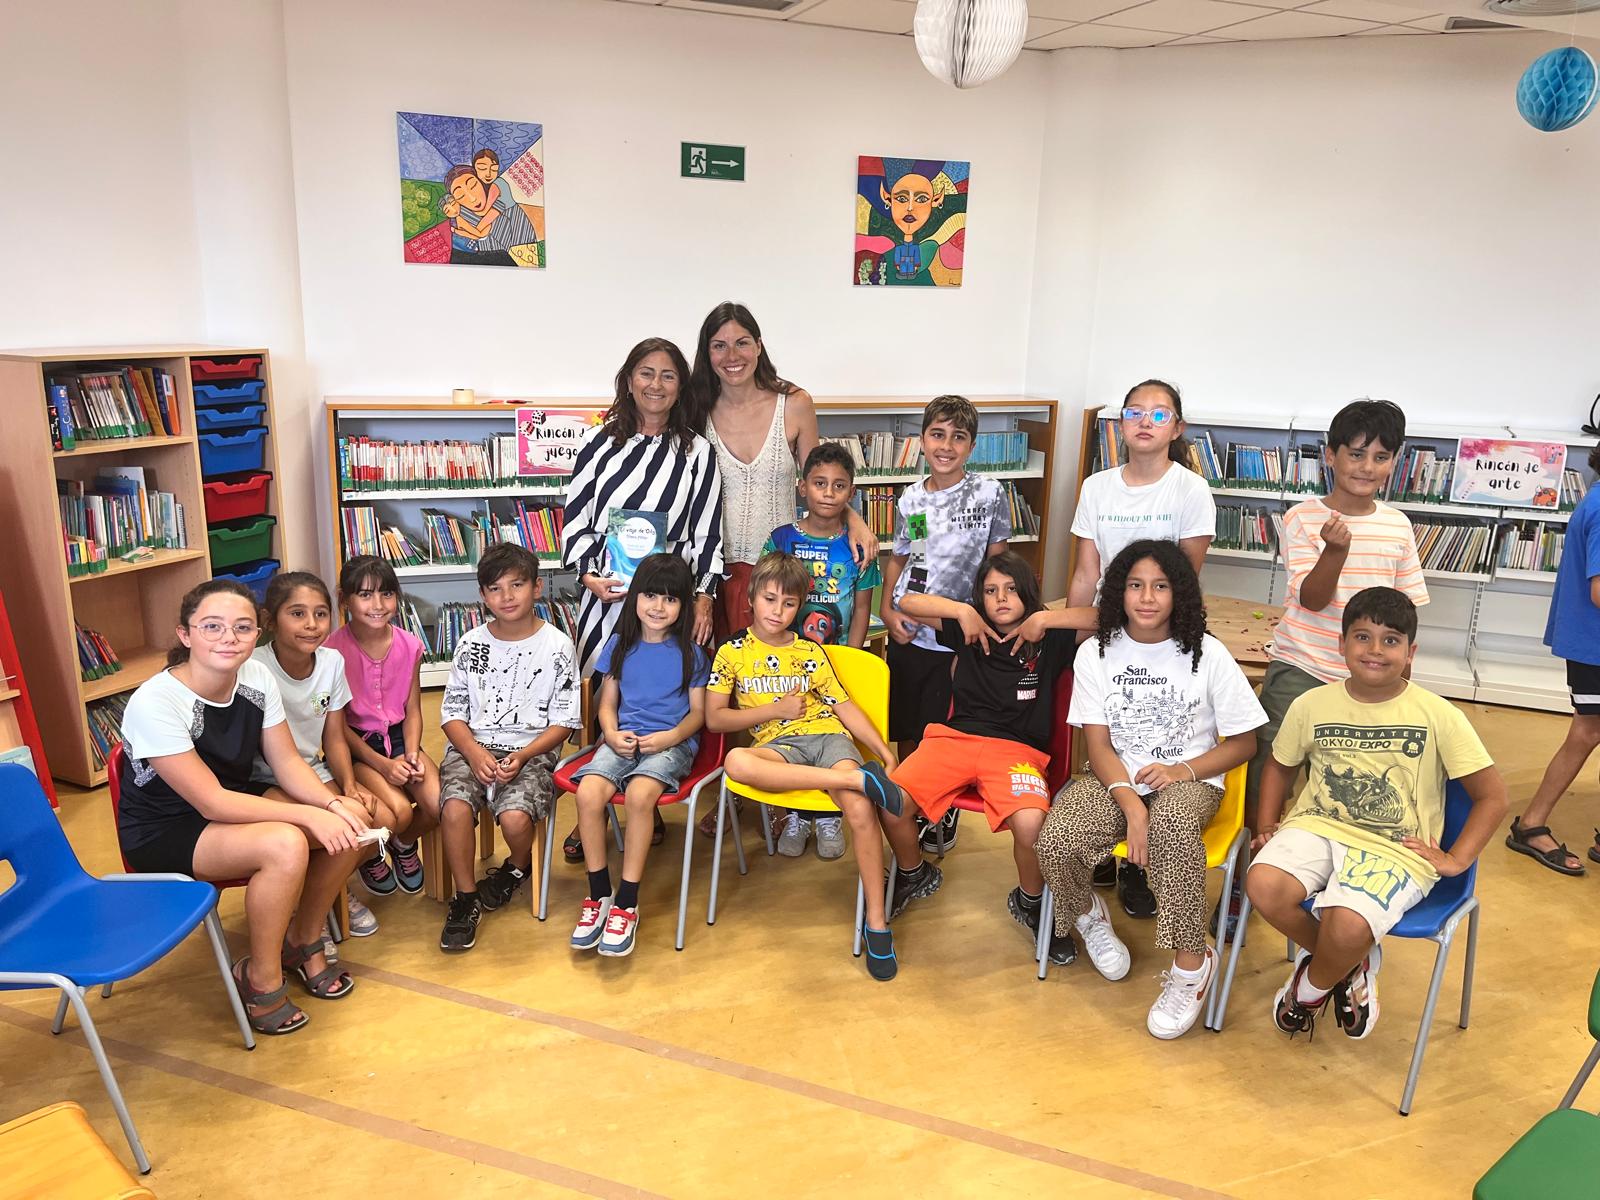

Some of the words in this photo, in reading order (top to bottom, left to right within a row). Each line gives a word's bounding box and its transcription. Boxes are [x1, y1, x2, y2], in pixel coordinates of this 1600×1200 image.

[536, 427, 575, 439] Rincón
[1476, 459, 1519, 472] Rincón
[1524, 462, 1540, 474] de
[1489, 478, 1521, 490] arte
[795, 549, 829, 560] SUPER
[469, 641, 481, 674] HYPE
[479, 643, 491, 675] 100%
[1123, 665, 1147, 676] San
[1112, 674, 1168, 685] Francisco
[1316, 729, 1422, 738] UNDERWATER
[1316, 738, 1354, 747] TOKYO
[1359, 740, 1392, 749] EXPO
[1151, 746, 1183, 759] Route
